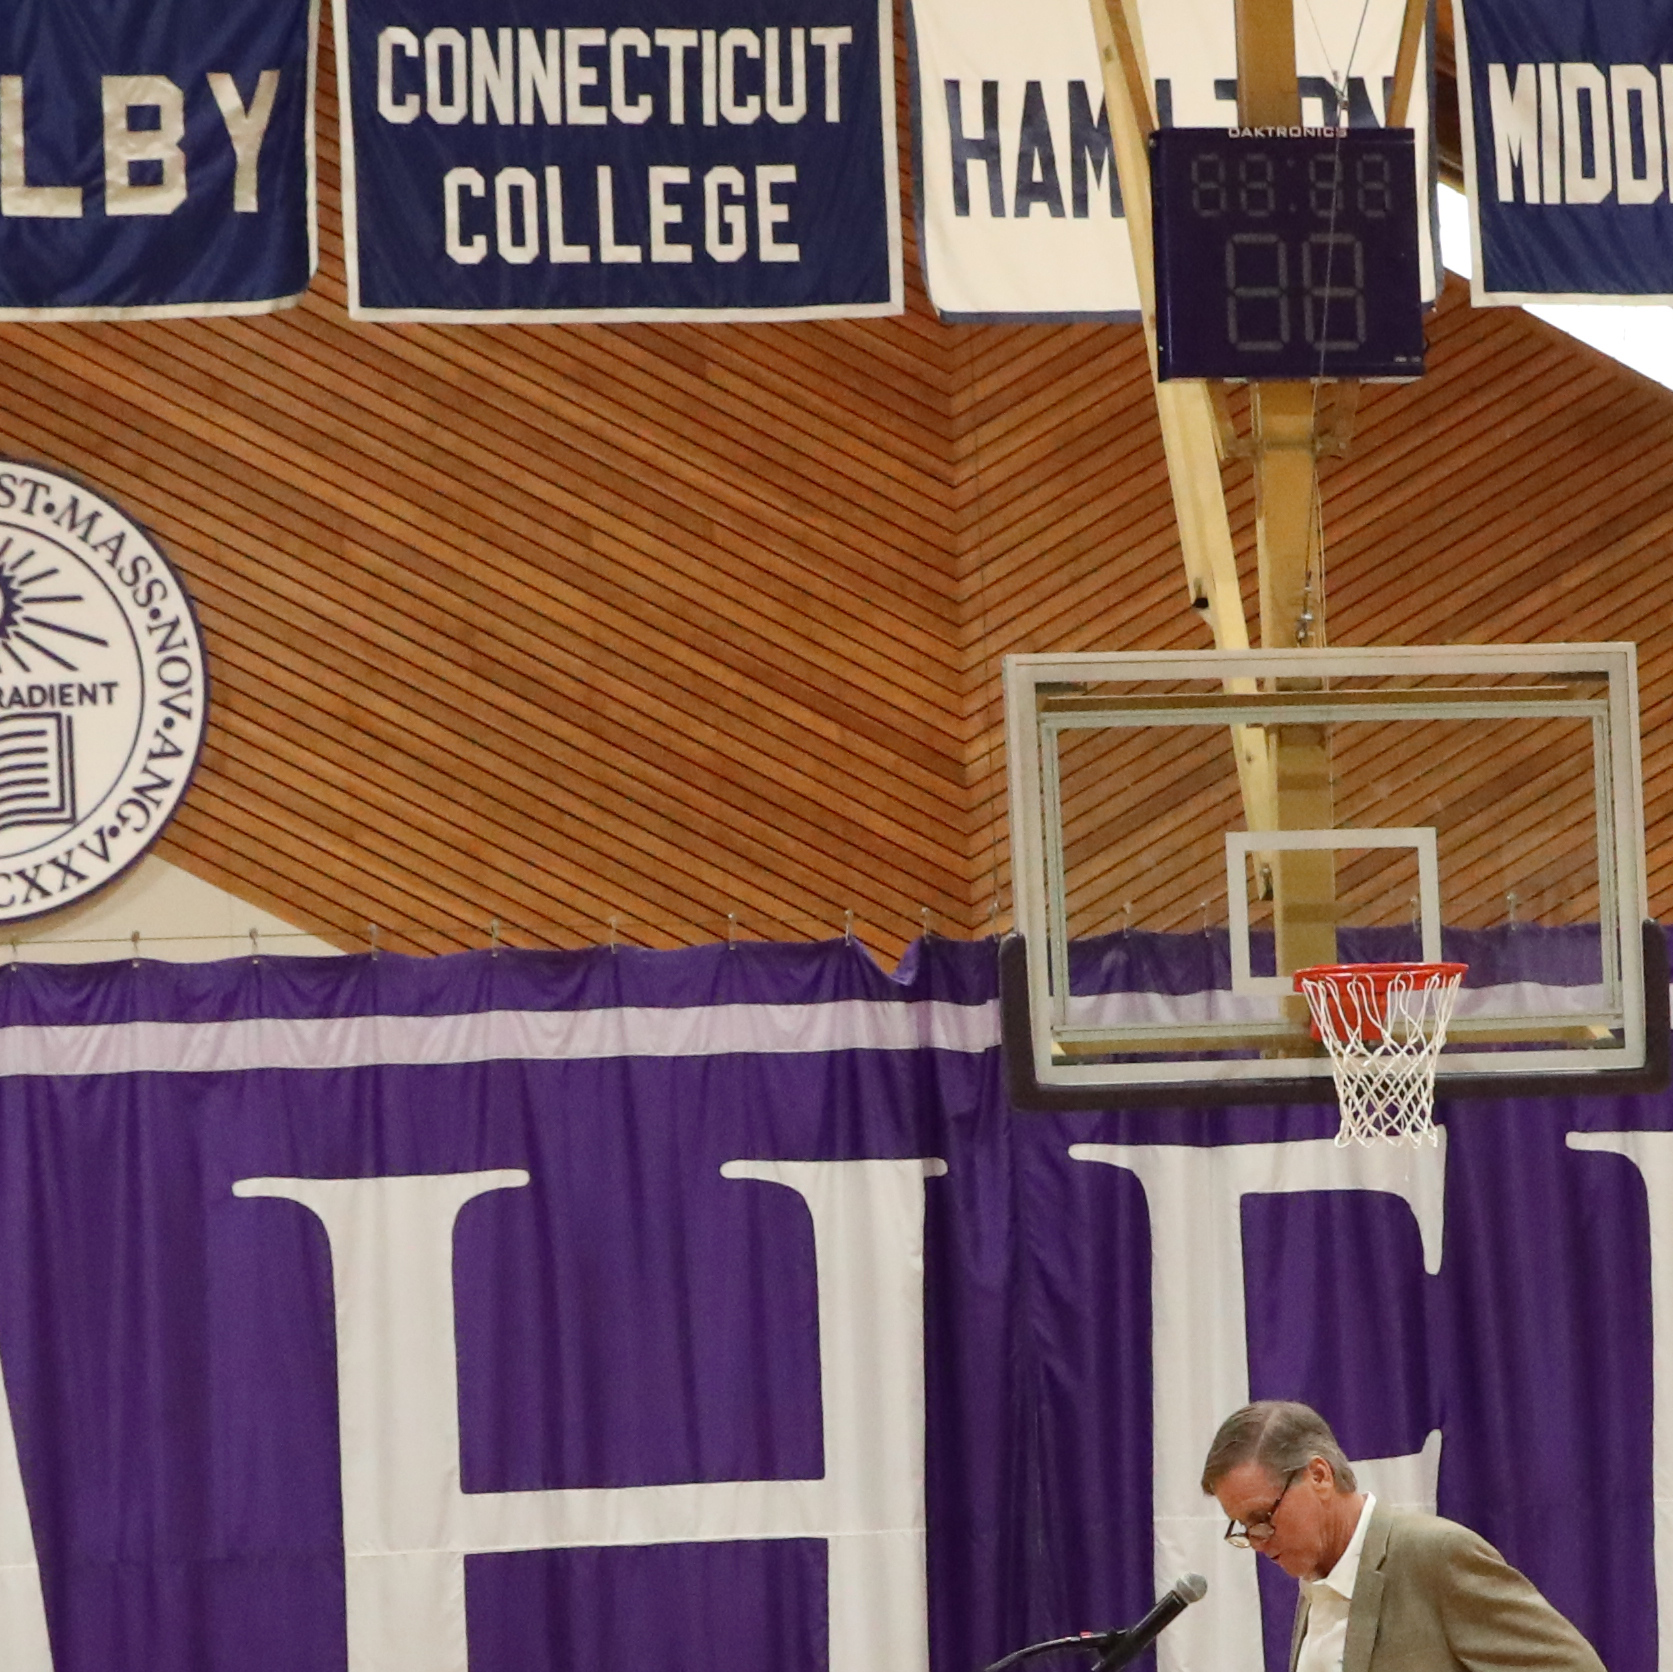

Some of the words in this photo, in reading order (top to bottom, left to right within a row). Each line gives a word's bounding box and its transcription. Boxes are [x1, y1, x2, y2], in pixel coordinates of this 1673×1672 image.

[377, 25, 853, 127] CONNECTICUT
[1228, 126, 1348, 139] DAKTRONICS
[442, 165, 800, 265] COLLEGE
[52, 496, 168, 609] MASS
[147, 614, 193, 721] NOV
[116, 728, 185, 834] ANG
